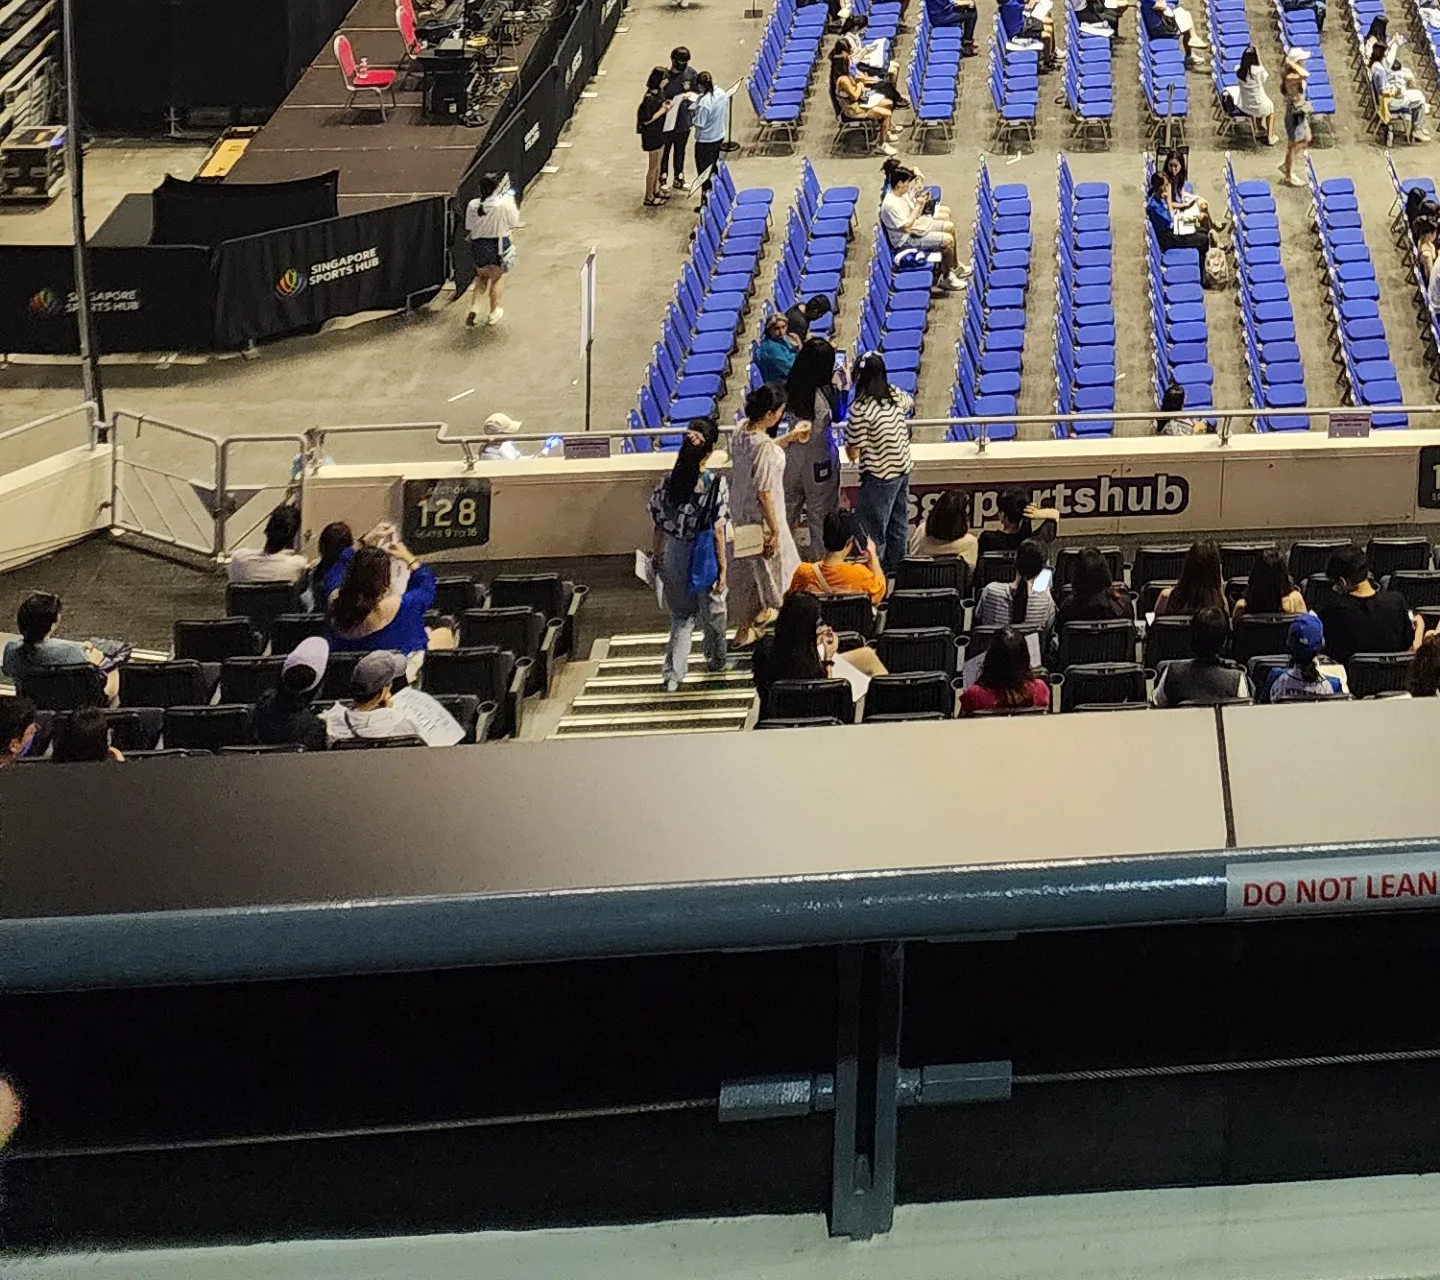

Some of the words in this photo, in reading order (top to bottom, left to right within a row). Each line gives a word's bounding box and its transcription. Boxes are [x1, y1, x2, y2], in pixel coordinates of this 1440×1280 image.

[309, 266, 354, 286] SPORTS
[354, 257, 380, 273] HUB
[311, 247, 378, 275] SINGAPORE
[112, 301, 140, 312] HUB
[418, 498, 477, 528] 128
[1243, 880, 1287, 908] DO
[1296, 875, 1358, 904] NOT
[1366, 870, 1438, 900] LEAN
